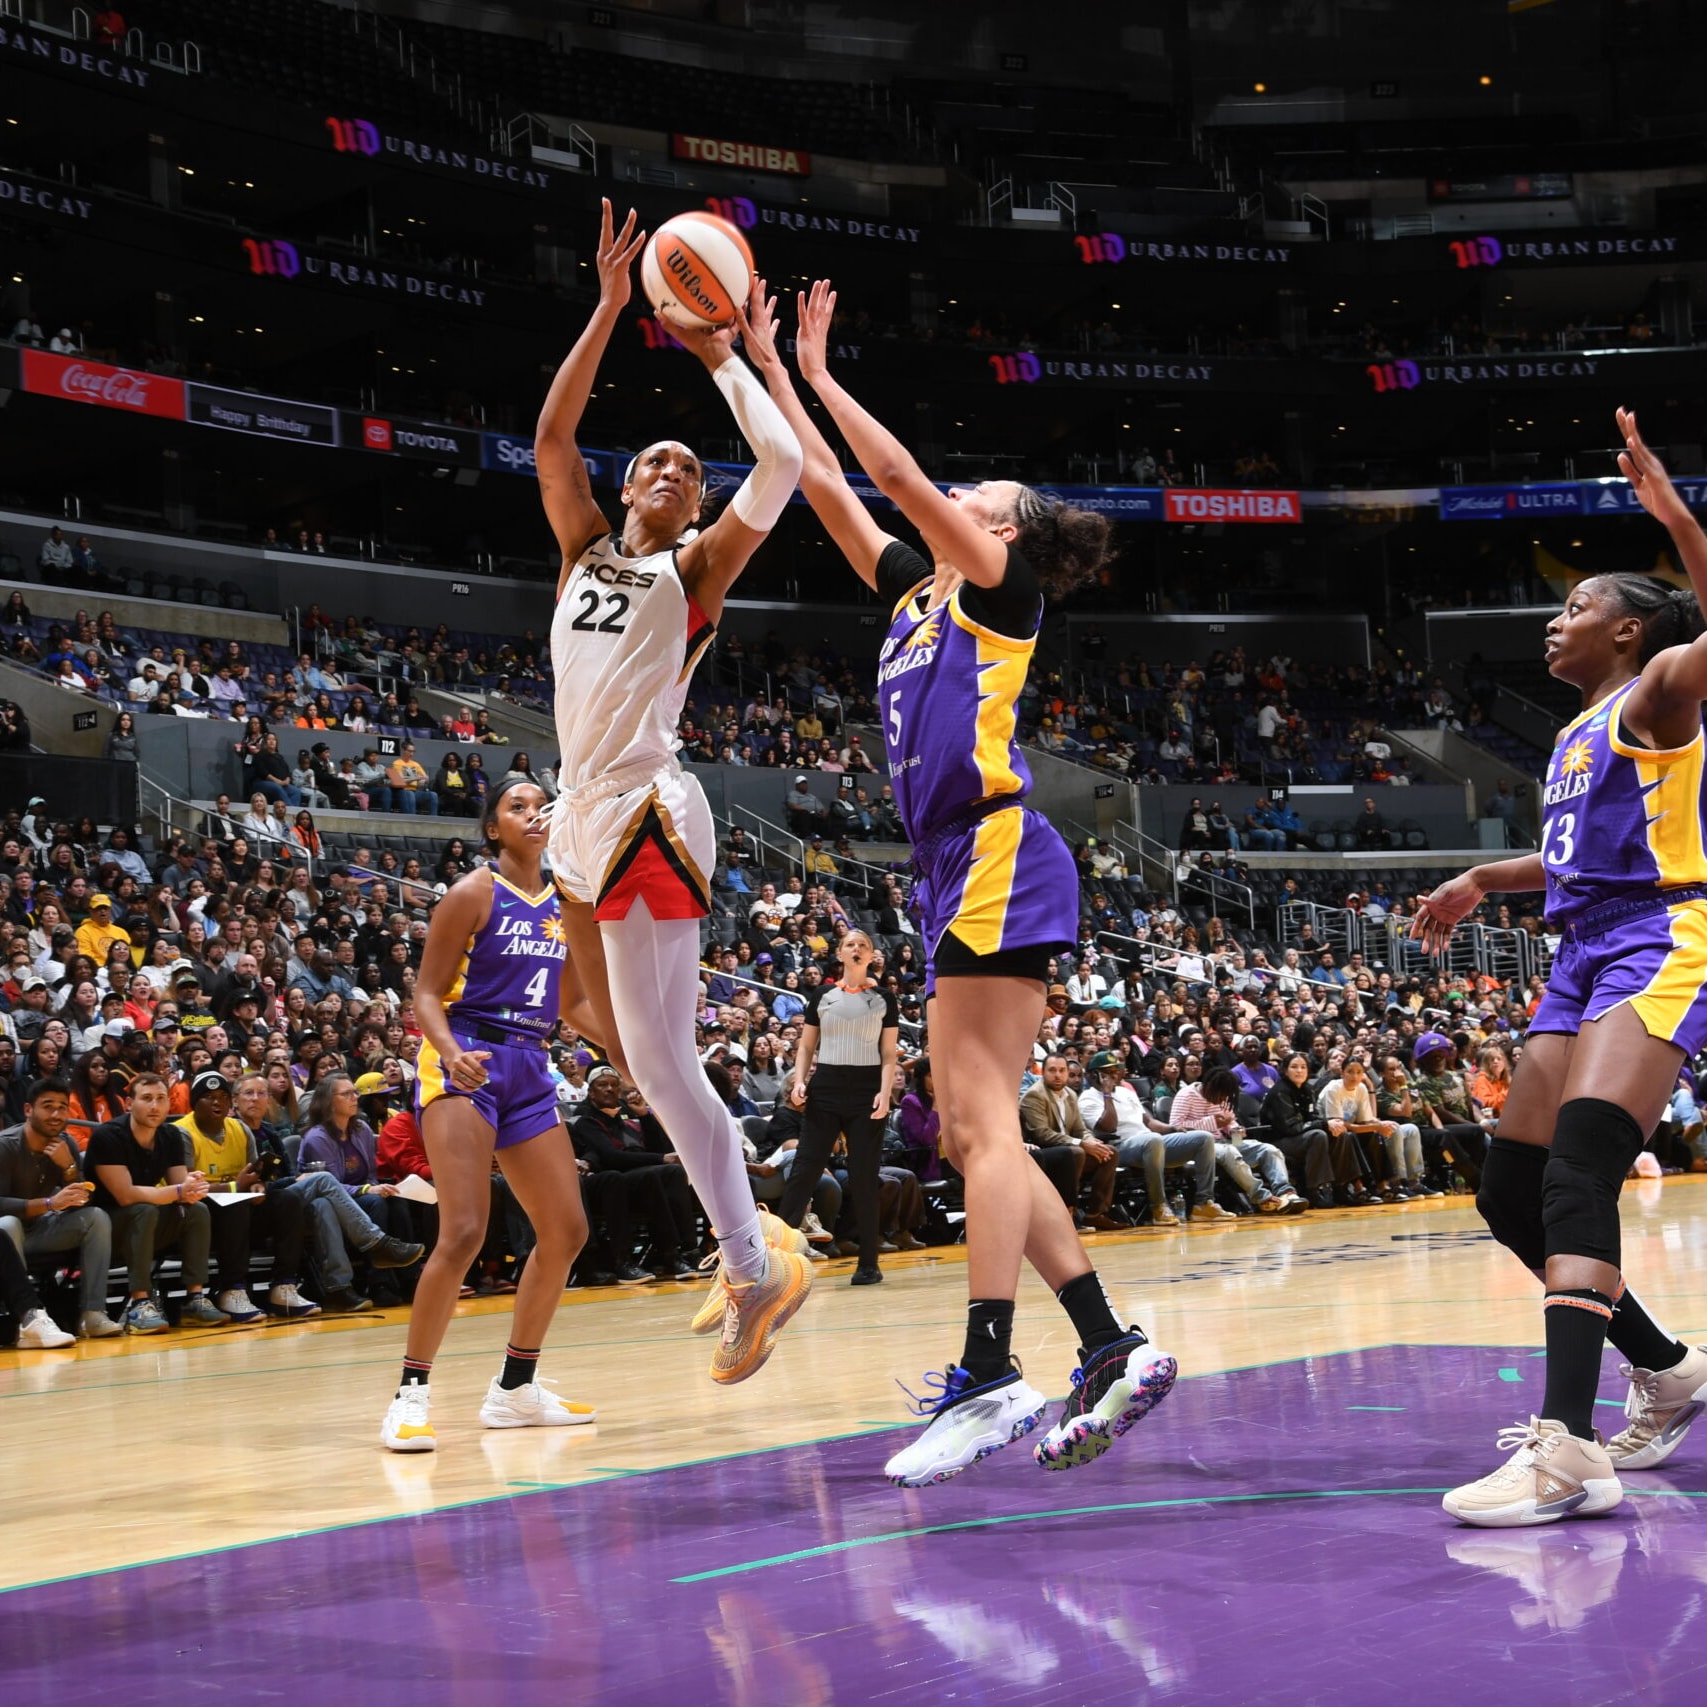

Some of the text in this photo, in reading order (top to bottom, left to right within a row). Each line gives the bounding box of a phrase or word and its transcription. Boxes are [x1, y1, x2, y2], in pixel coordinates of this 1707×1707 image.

[59, 45, 150, 88] DECAY
[385, 135, 468, 168] URBAN
[474, 157, 550, 188] DECAY
[682, 136, 801, 174] TOSHIBA
[0, 180, 93, 218] DECAY
[761, 207, 841, 232] URBAN
[847, 219, 920, 243] DECAY
[1129, 242, 1209, 262] URBAN
[1215, 246, 1291, 263] DECAY
[1505, 240, 1591, 260] URBAN
[1597, 237, 1678, 255] DECAY
[305, 256, 399, 289] URBAN
[405, 276, 487, 306] DECAY
[667, 249, 719, 315] Wilson
[1045, 361, 1129, 380] URBAN
[1135, 362, 1213, 381] DECAY
[1425, 364, 1510, 384] URBAN
[1518, 361, 1599, 378] DECAY
[209, 404, 312, 437] Happy Birthday
[394, 430, 459, 453] TOYOTA
[1170, 494, 1295, 517] TOSHIBA
[1518, 493, 1578, 508] ULTRA
[452, 583, 470, 595] PR16
[579, 563, 658, 589] ACES
[571, 589, 630, 634] 22
[889, 690, 902, 747] 5
[381, 739, 396, 754] 112
[841, 776, 853, 788] 113
[1272, 789, 1284, 800] 114
[1541, 813, 1575, 869] 13
[524, 967, 549, 1007] 4
[513, 1011, 552, 1029] EquiTrust
